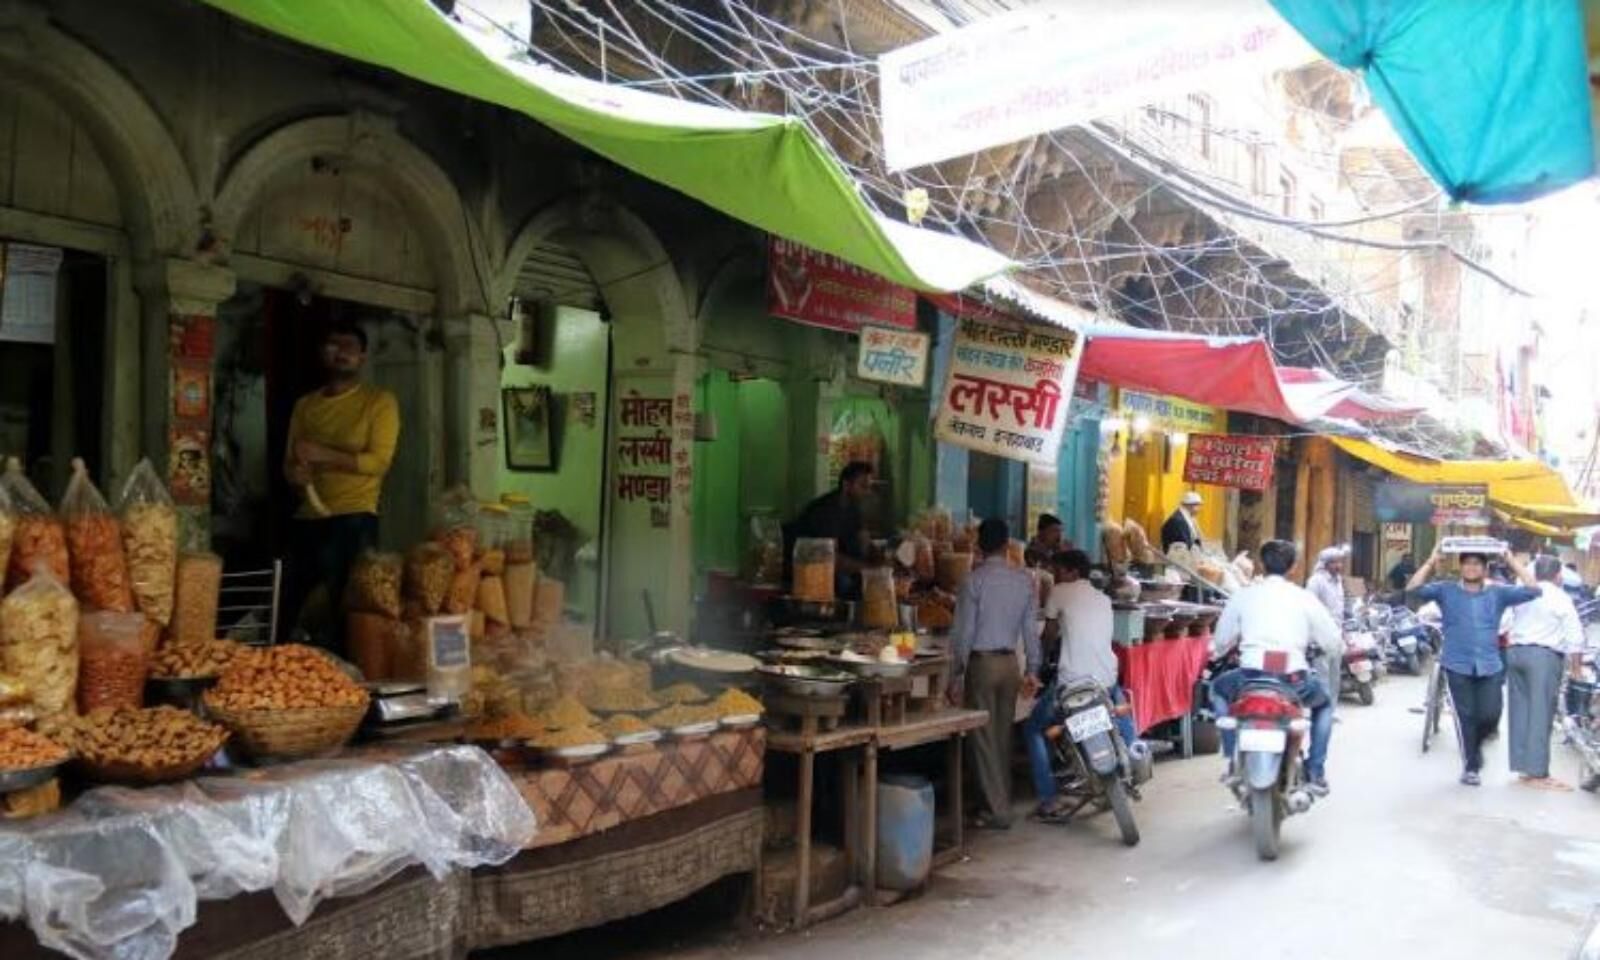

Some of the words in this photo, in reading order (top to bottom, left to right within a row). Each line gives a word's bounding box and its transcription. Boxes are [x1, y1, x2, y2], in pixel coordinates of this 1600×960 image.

[1029, 331, 1075, 358] भण्डार
[619, 389, 673, 428] मोहन
[951, 374, 1061, 428] लस्सी
